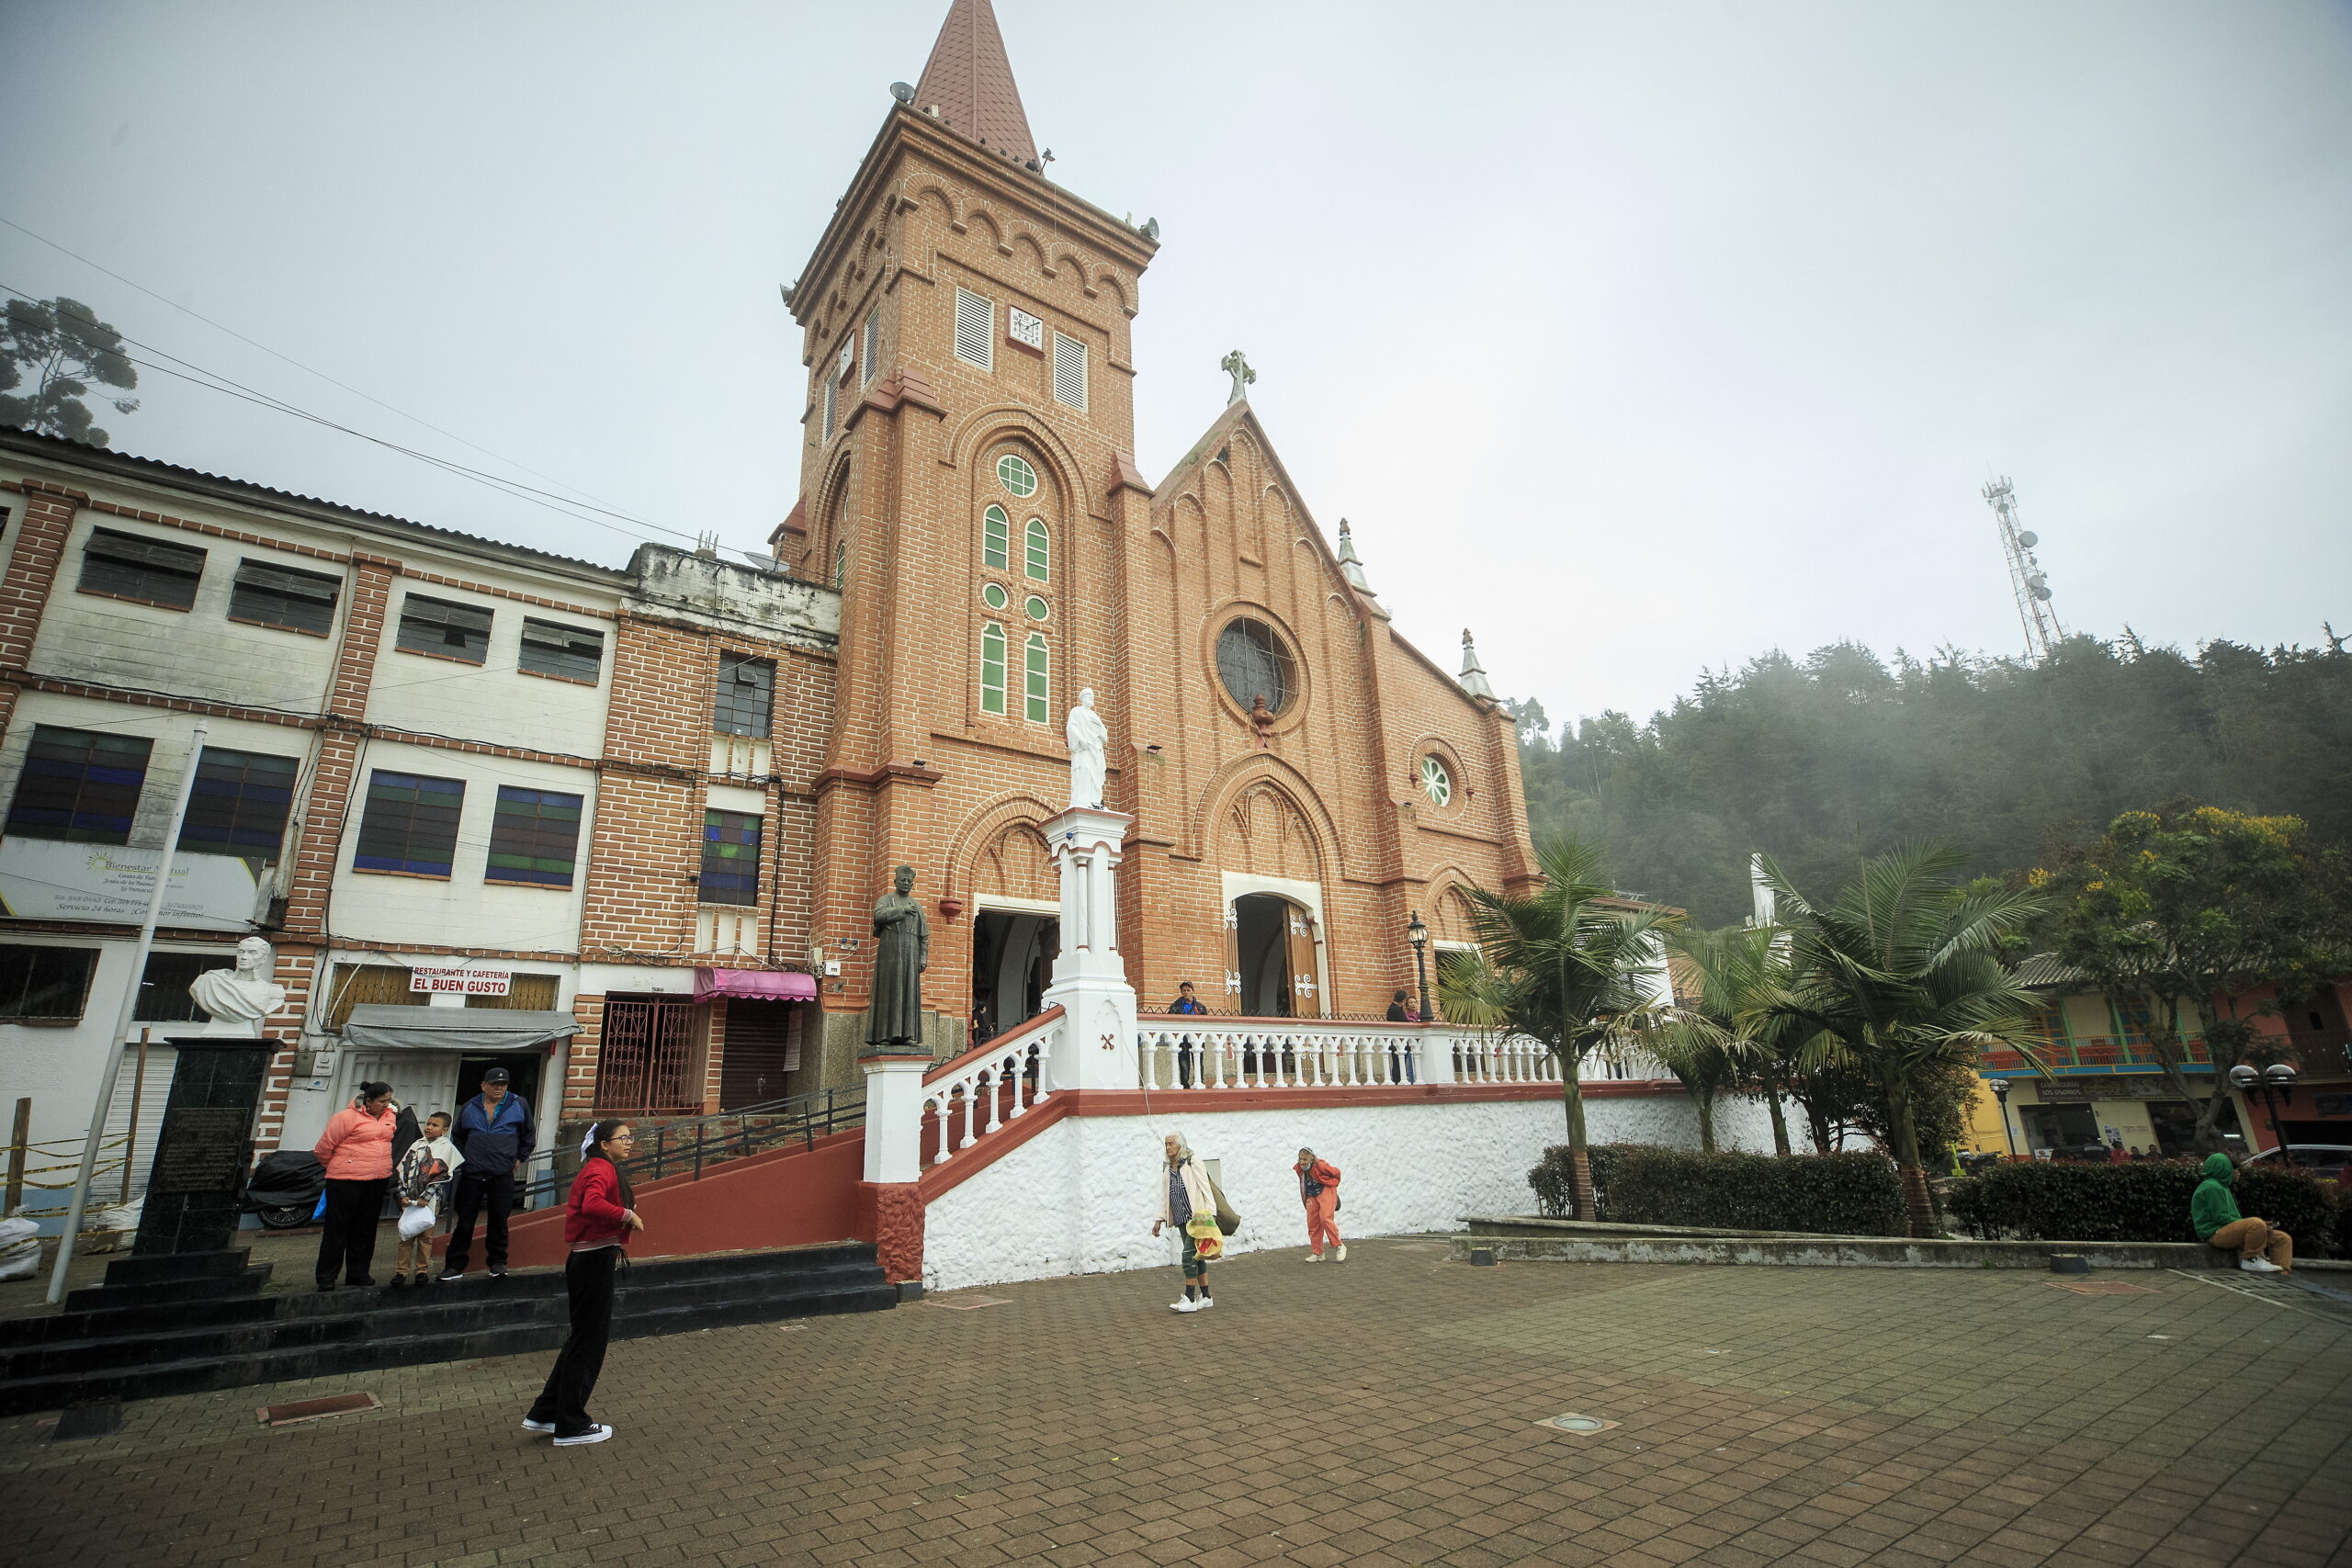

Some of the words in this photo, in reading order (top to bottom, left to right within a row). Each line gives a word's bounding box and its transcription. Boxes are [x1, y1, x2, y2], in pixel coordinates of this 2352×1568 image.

[106, 862, 152, 871] Bienestar
[154, 865, 189, 874] Mtual
[415, 967, 464, 976] RESTAURANTE
[473, 970, 509, 979] CAFETERÍA
[413, 978, 428, 989] EL
[432, 979, 464, 991] BUEN
[468, 981, 505, 993] GUSTO
